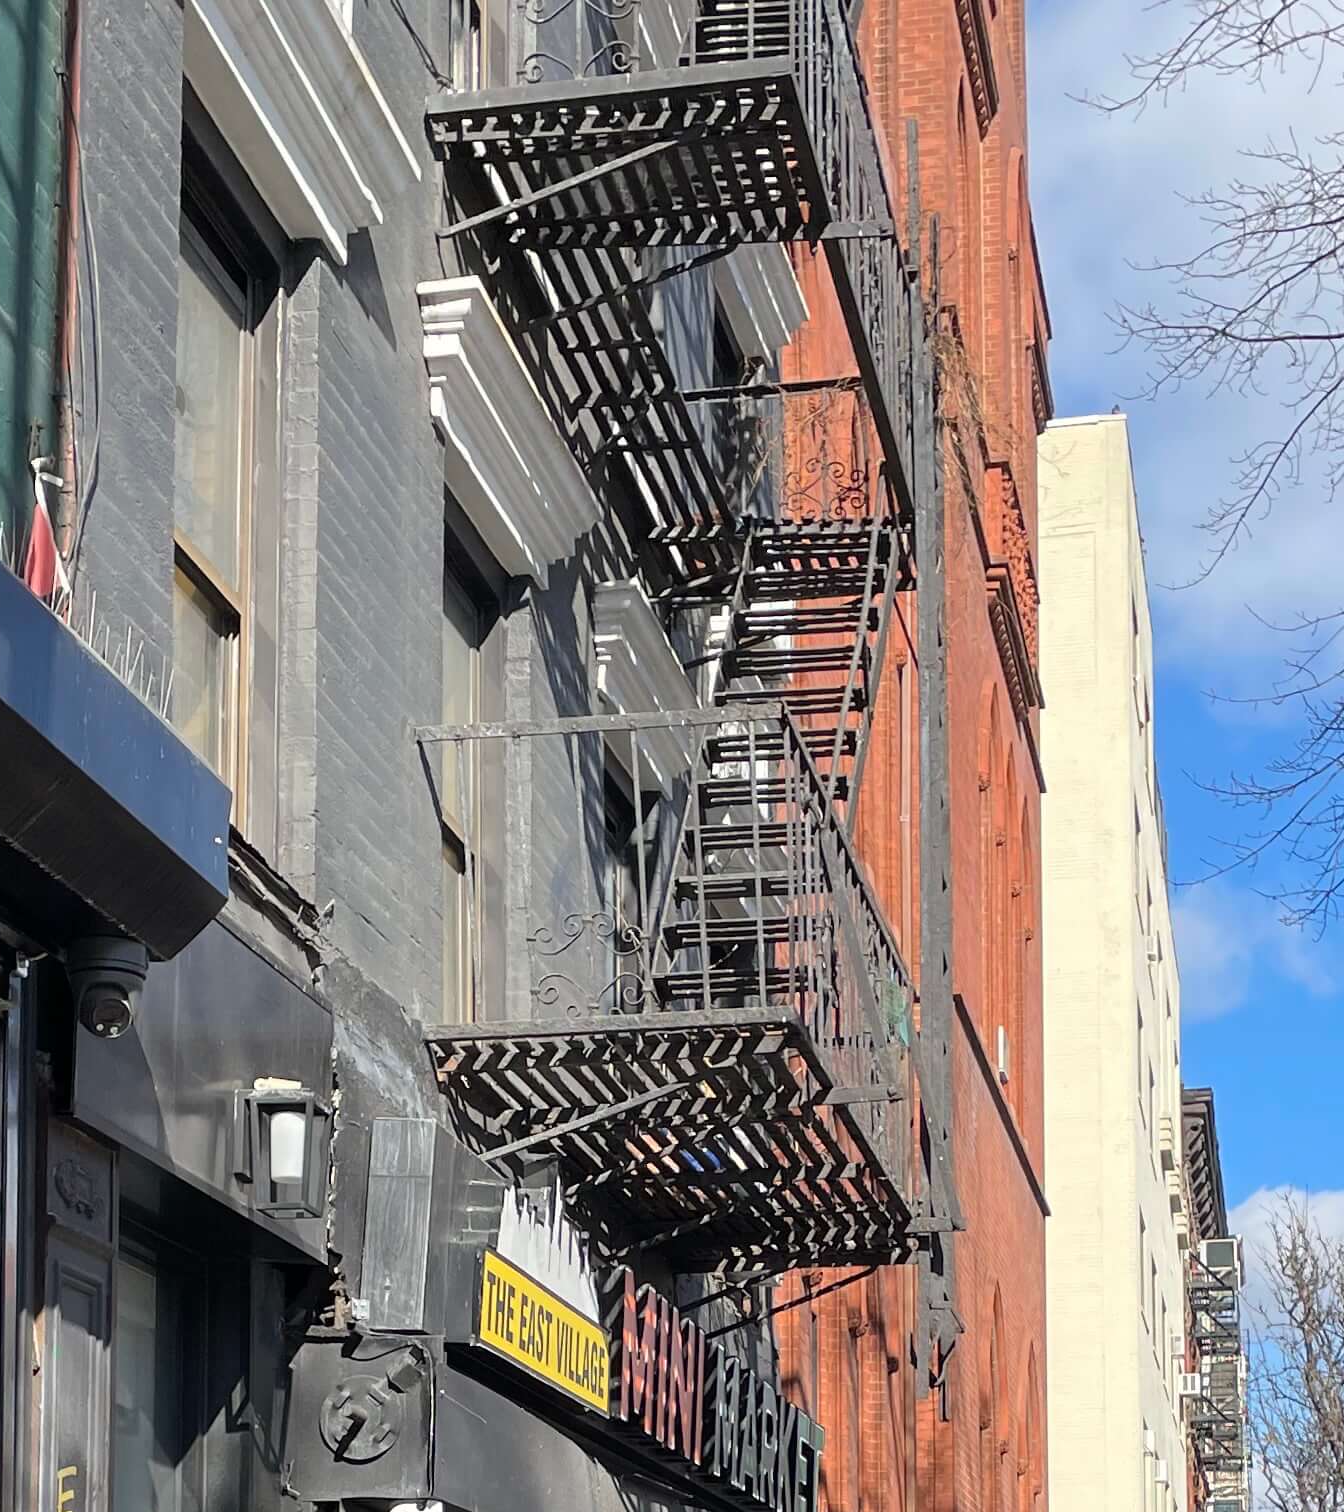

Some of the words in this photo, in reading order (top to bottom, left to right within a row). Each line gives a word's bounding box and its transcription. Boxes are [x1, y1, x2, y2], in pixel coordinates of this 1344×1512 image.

[485, 1270, 515, 1346] THE
[519, 1287, 553, 1367] EAST
[556, 1305, 606, 1400] VILLAGE
[619, 1265, 709, 1466] MINI
